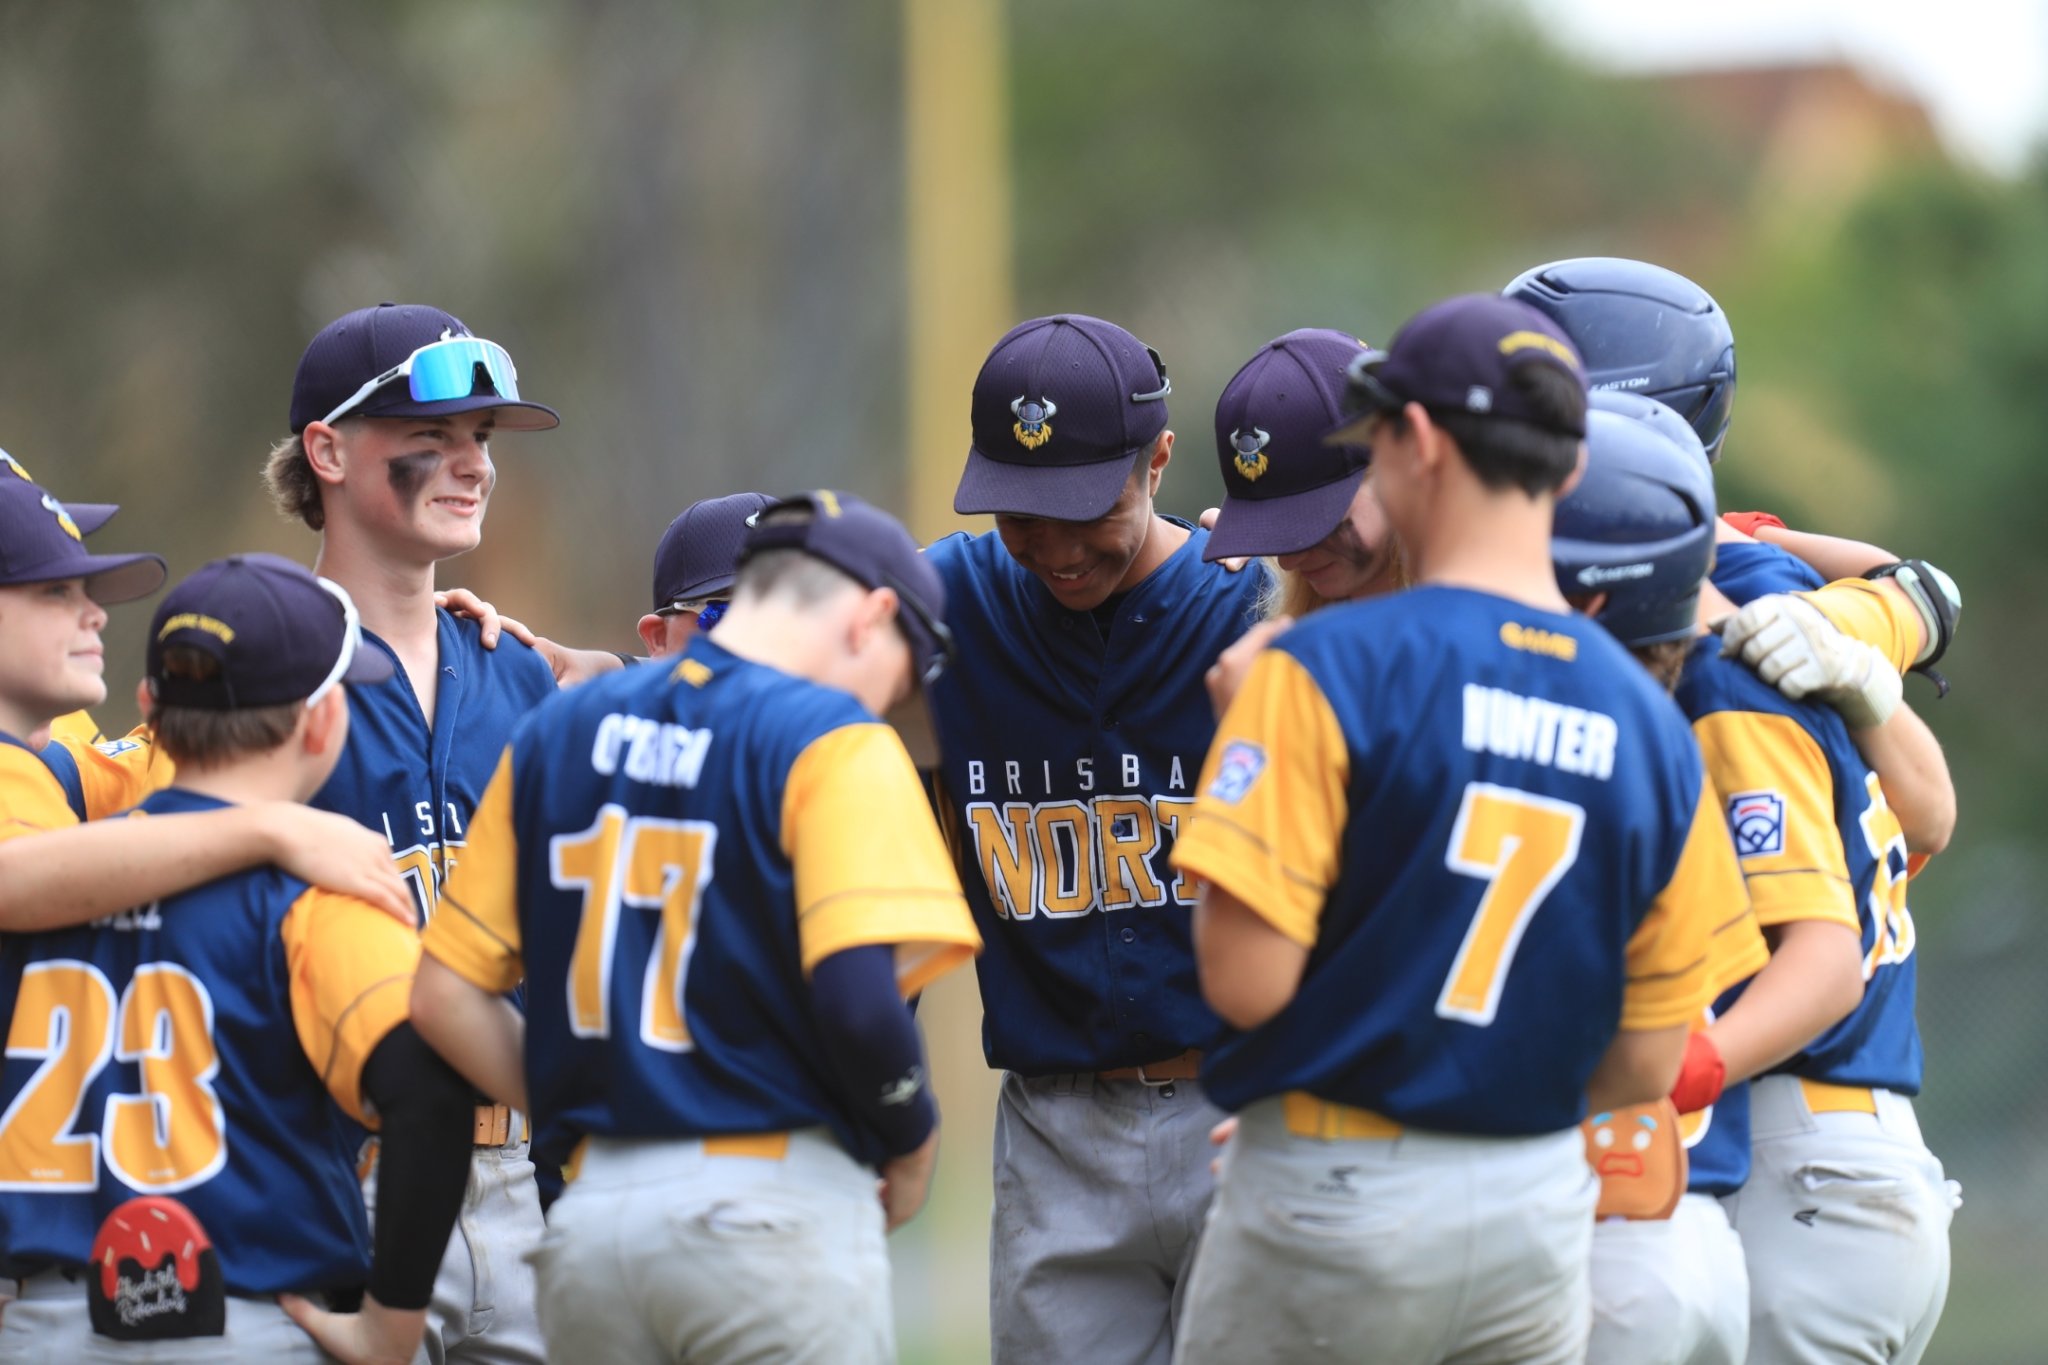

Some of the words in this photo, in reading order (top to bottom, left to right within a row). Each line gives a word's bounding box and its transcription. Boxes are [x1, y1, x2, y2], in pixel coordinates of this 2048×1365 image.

[969, 754, 1185, 795] BRISBA
[549, 802, 718, 1053] 17
[1435, 781, 1587, 1028] 7
[0, 958, 229, 1194] 23
